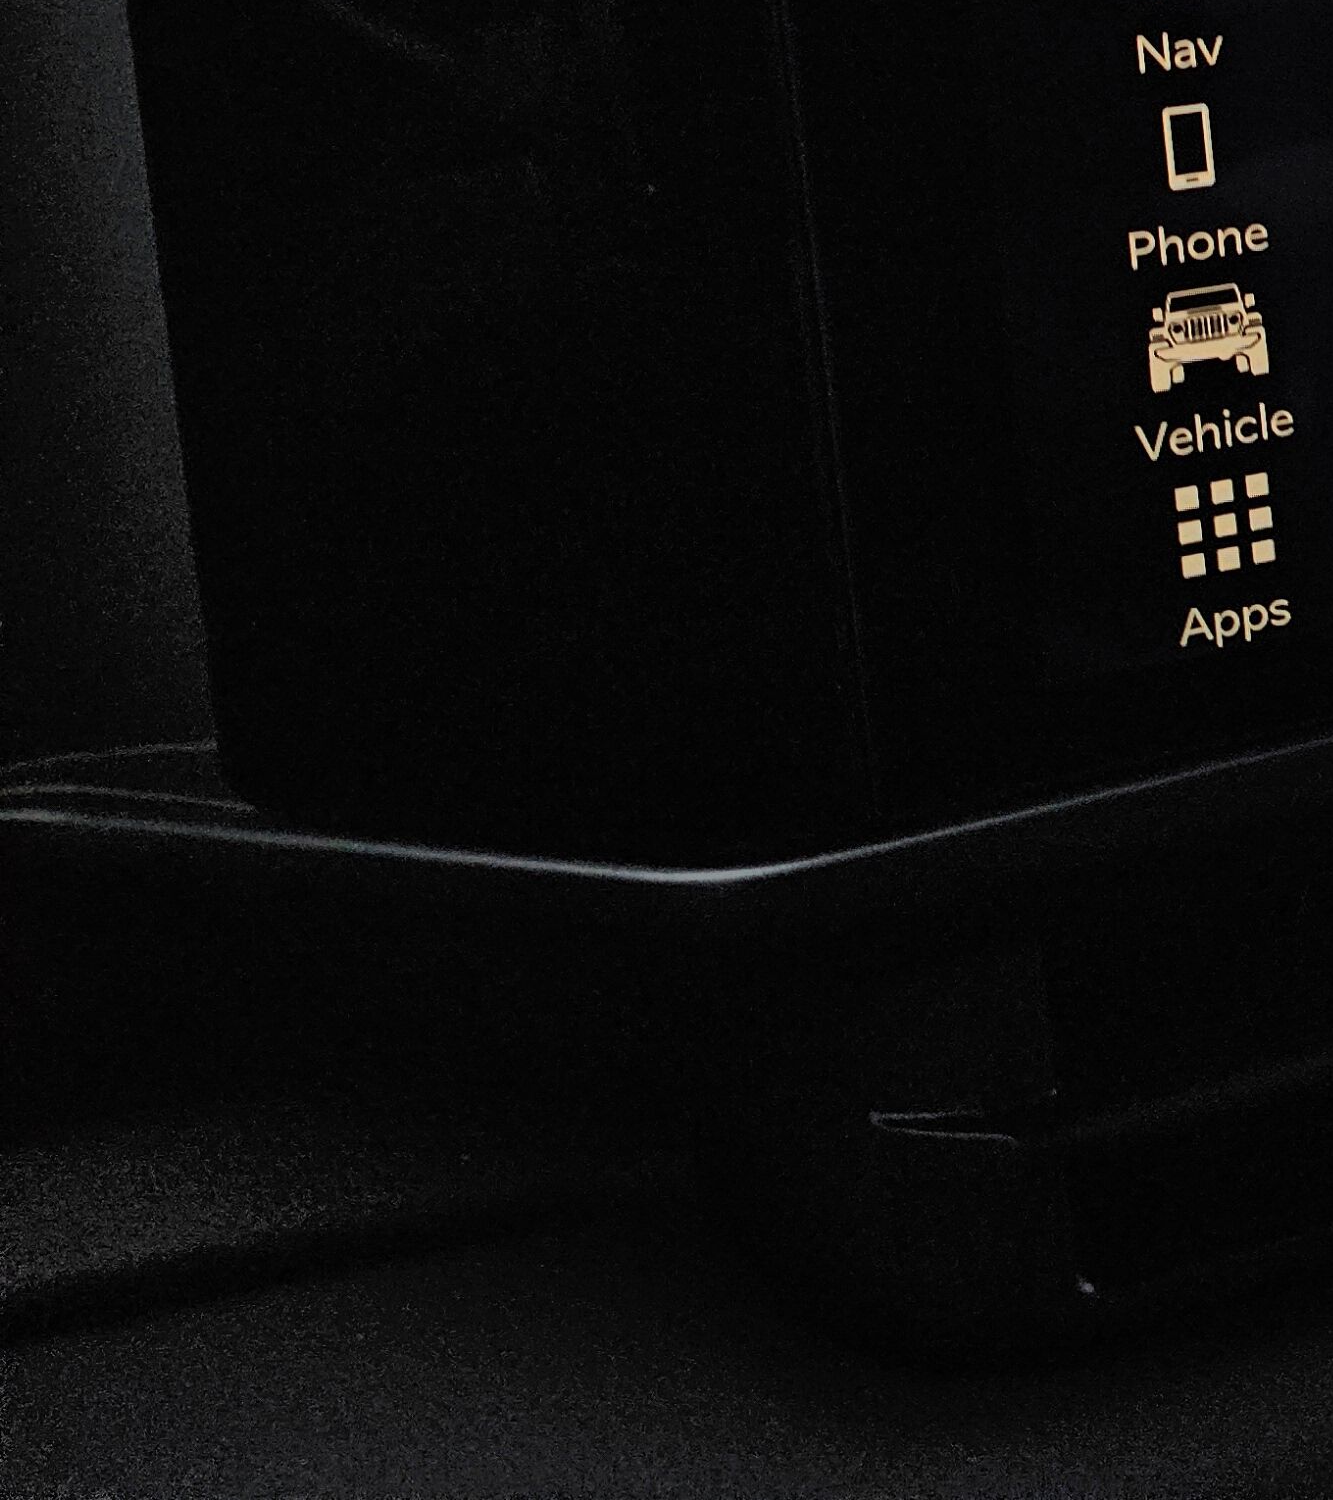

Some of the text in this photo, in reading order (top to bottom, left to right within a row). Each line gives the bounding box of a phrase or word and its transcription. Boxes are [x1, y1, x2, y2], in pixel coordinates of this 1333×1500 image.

[1136, 31, 1223, 74] Nav
[1128, 223, 1269, 271] Phone
[1134, 402, 1294, 461] Vehicle
[1179, 598, 1292, 648] Apps
